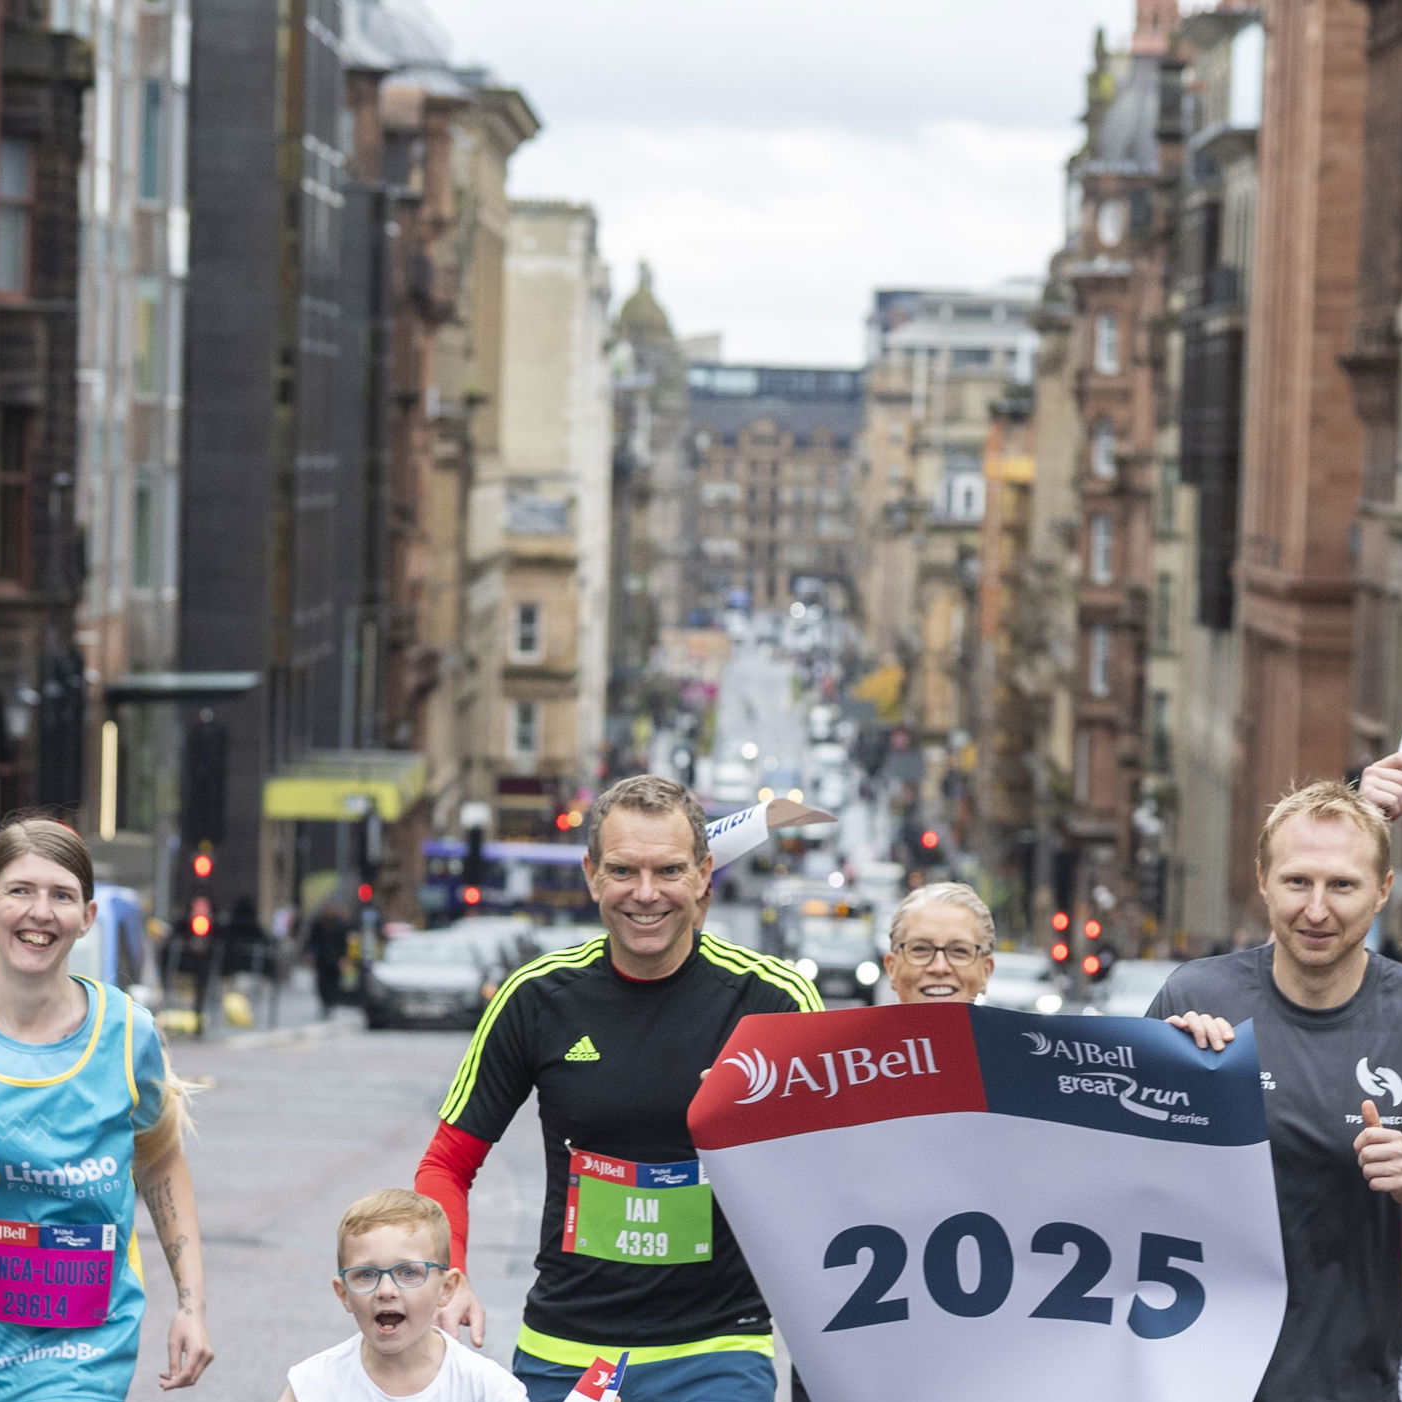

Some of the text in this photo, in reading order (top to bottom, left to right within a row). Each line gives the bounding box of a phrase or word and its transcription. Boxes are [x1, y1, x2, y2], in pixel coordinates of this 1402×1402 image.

[780, 1038, 941, 1099] AJBell
[1052, 1039, 1137, 1069] AJBell
[1057, 1074, 1190, 1107] great run
[1170, 1112, 1209, 1126] series
[7, 1179, 121, 1199] Foundation
[625, 1196, 659, 1223] IAN
[615, 1230, 668, 1257] 4339
[821, 1211, 1206, 1340] 2025
[3, 1291, 68, 1320] 29614
